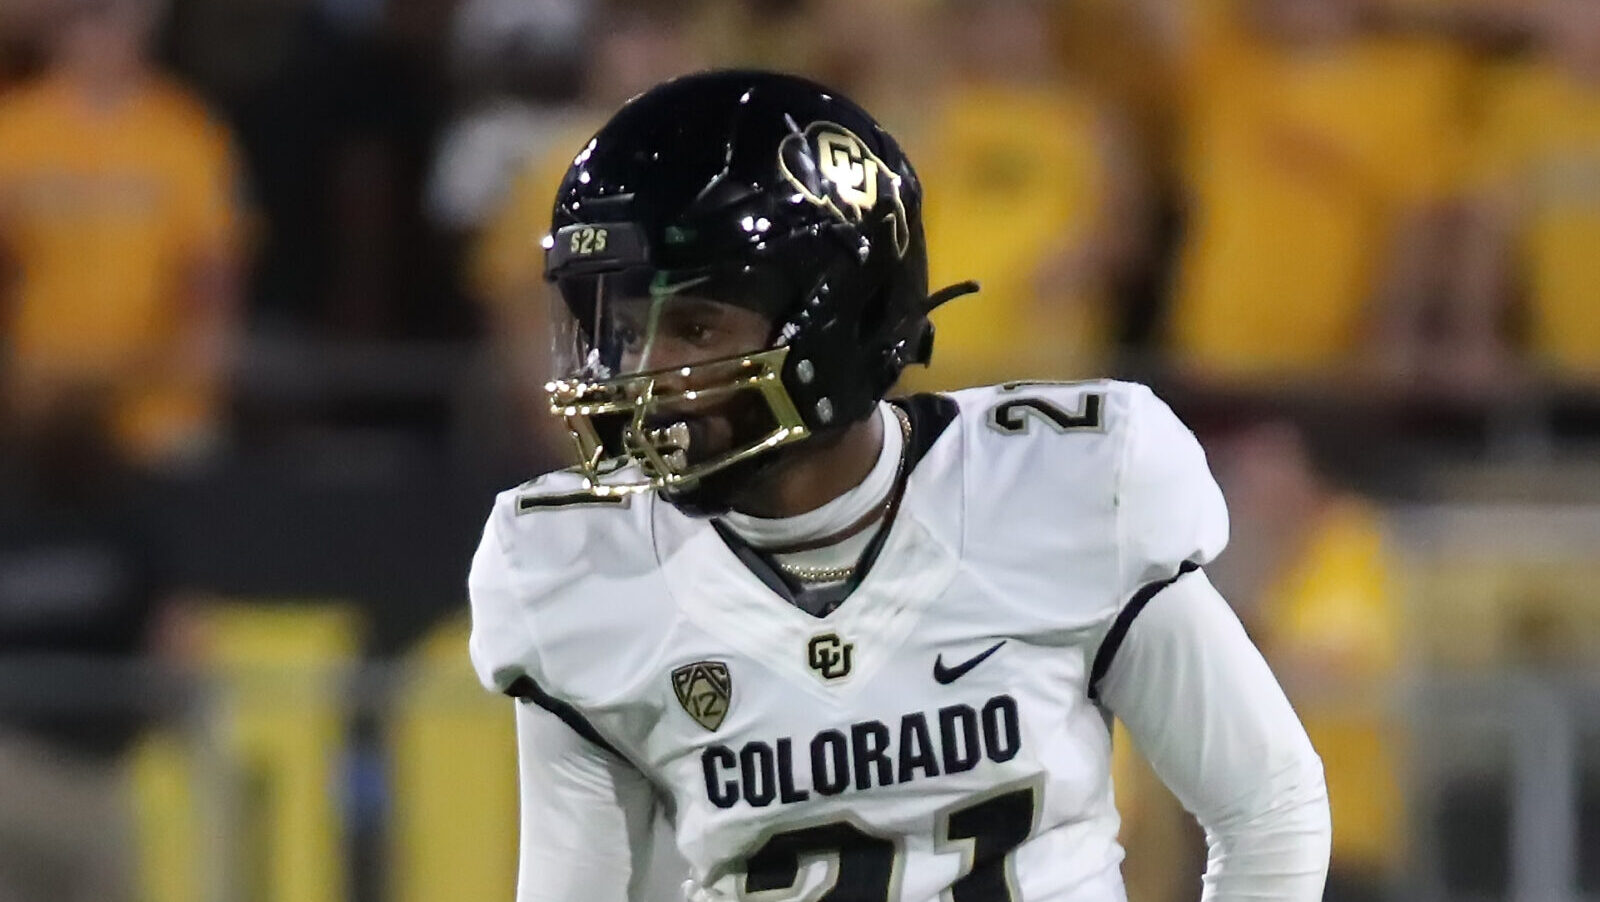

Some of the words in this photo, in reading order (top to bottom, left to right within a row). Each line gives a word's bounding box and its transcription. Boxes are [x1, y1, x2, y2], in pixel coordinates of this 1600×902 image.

[817, 132, 878, 211] CU
[985, 378, 1107, 436] 2
[673, 661, 731, 702] PAC
[807, 633, 854, 680] CU
[691, 690, 722, 718] 12
[701, 694, 1021, 809] COLORADO
